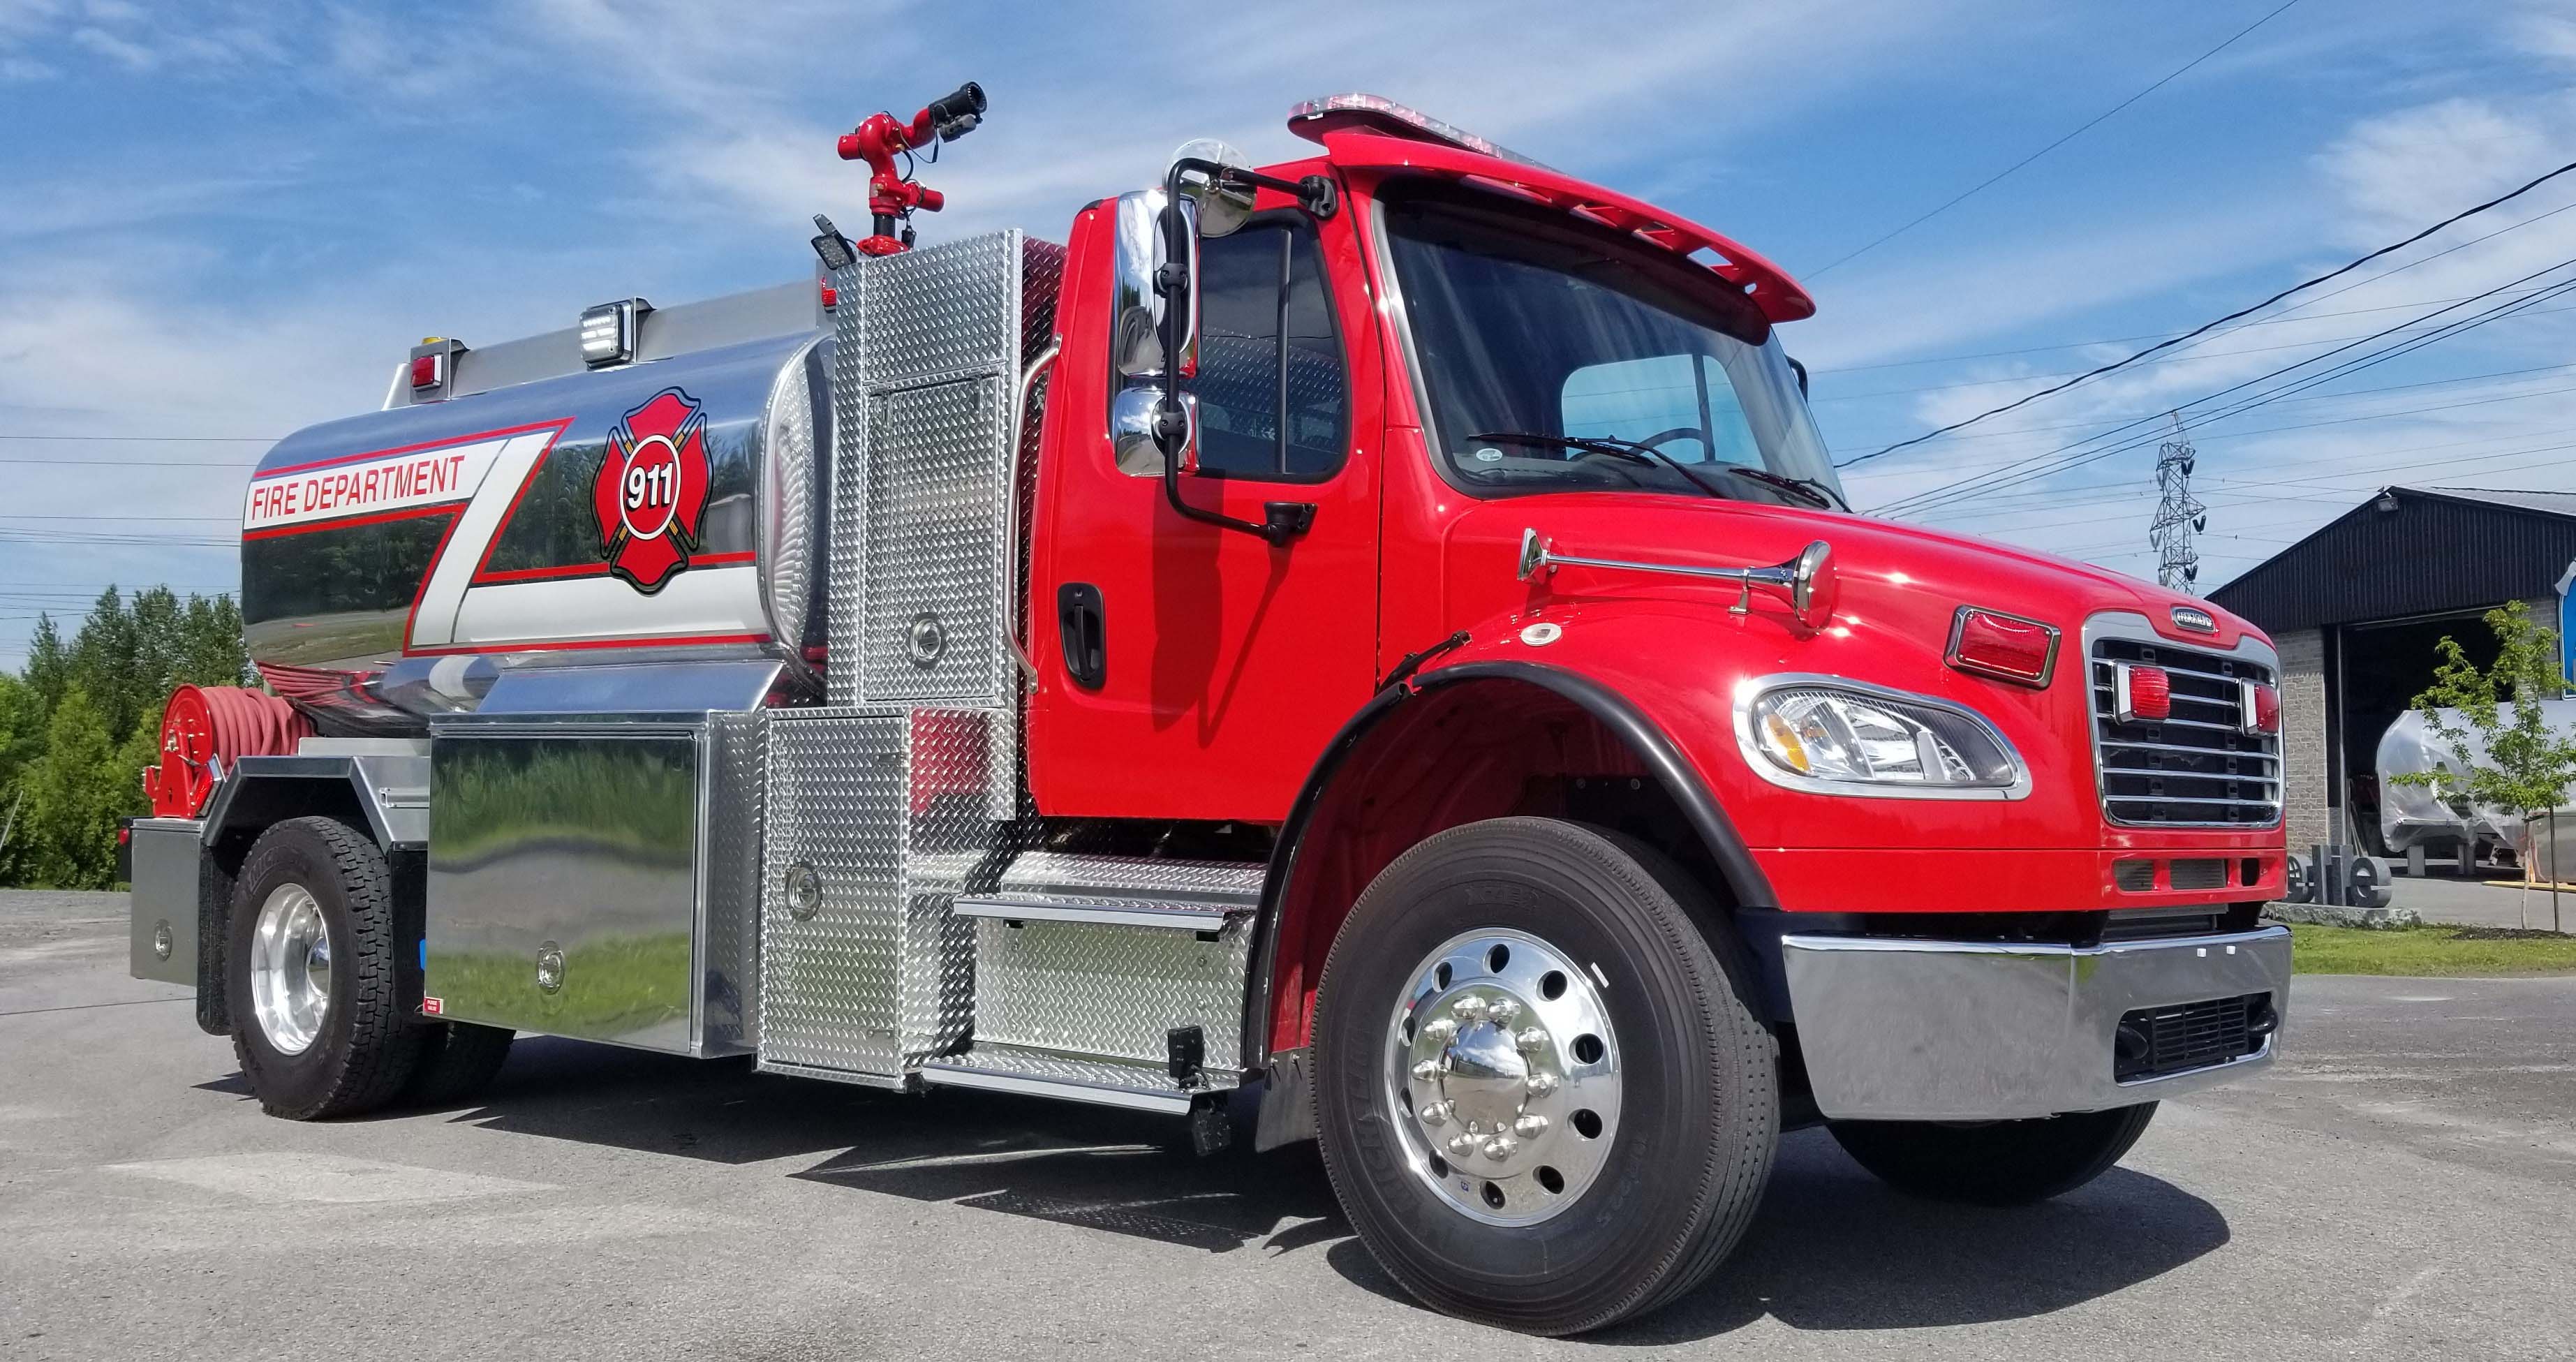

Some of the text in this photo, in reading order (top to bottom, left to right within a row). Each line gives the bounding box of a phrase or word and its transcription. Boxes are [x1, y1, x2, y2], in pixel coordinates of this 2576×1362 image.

[252, 454, 465, 521] FIRE DEPARTMENT
[626, 461, 673, 511] 911
